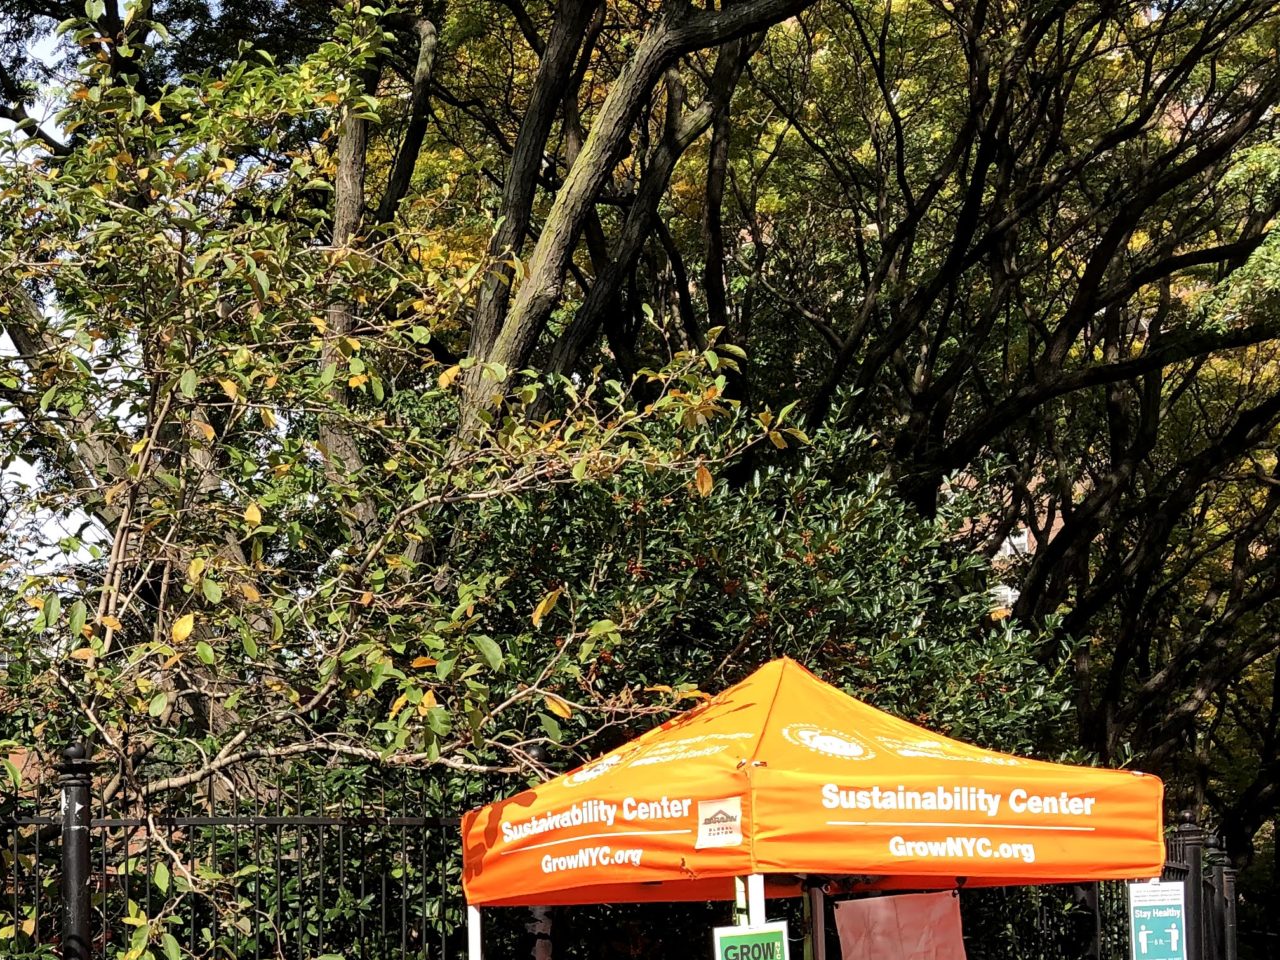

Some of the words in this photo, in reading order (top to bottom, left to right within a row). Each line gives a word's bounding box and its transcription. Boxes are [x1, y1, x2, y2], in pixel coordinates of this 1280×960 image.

[821, 783, 1001, 817] Sustainability
[1008, 785, 1096, 817] Center
[501, 800, 617, 843] Sustainability
[623, 797, 691, 821] Center
[541, 846, 643, 873] GrowNYC.org
[889, 836, 1035, 863] GrowNYC.org
[1134, 909, 1151, 920] Stay
[1153, 907, 1181, 918] Healthy
